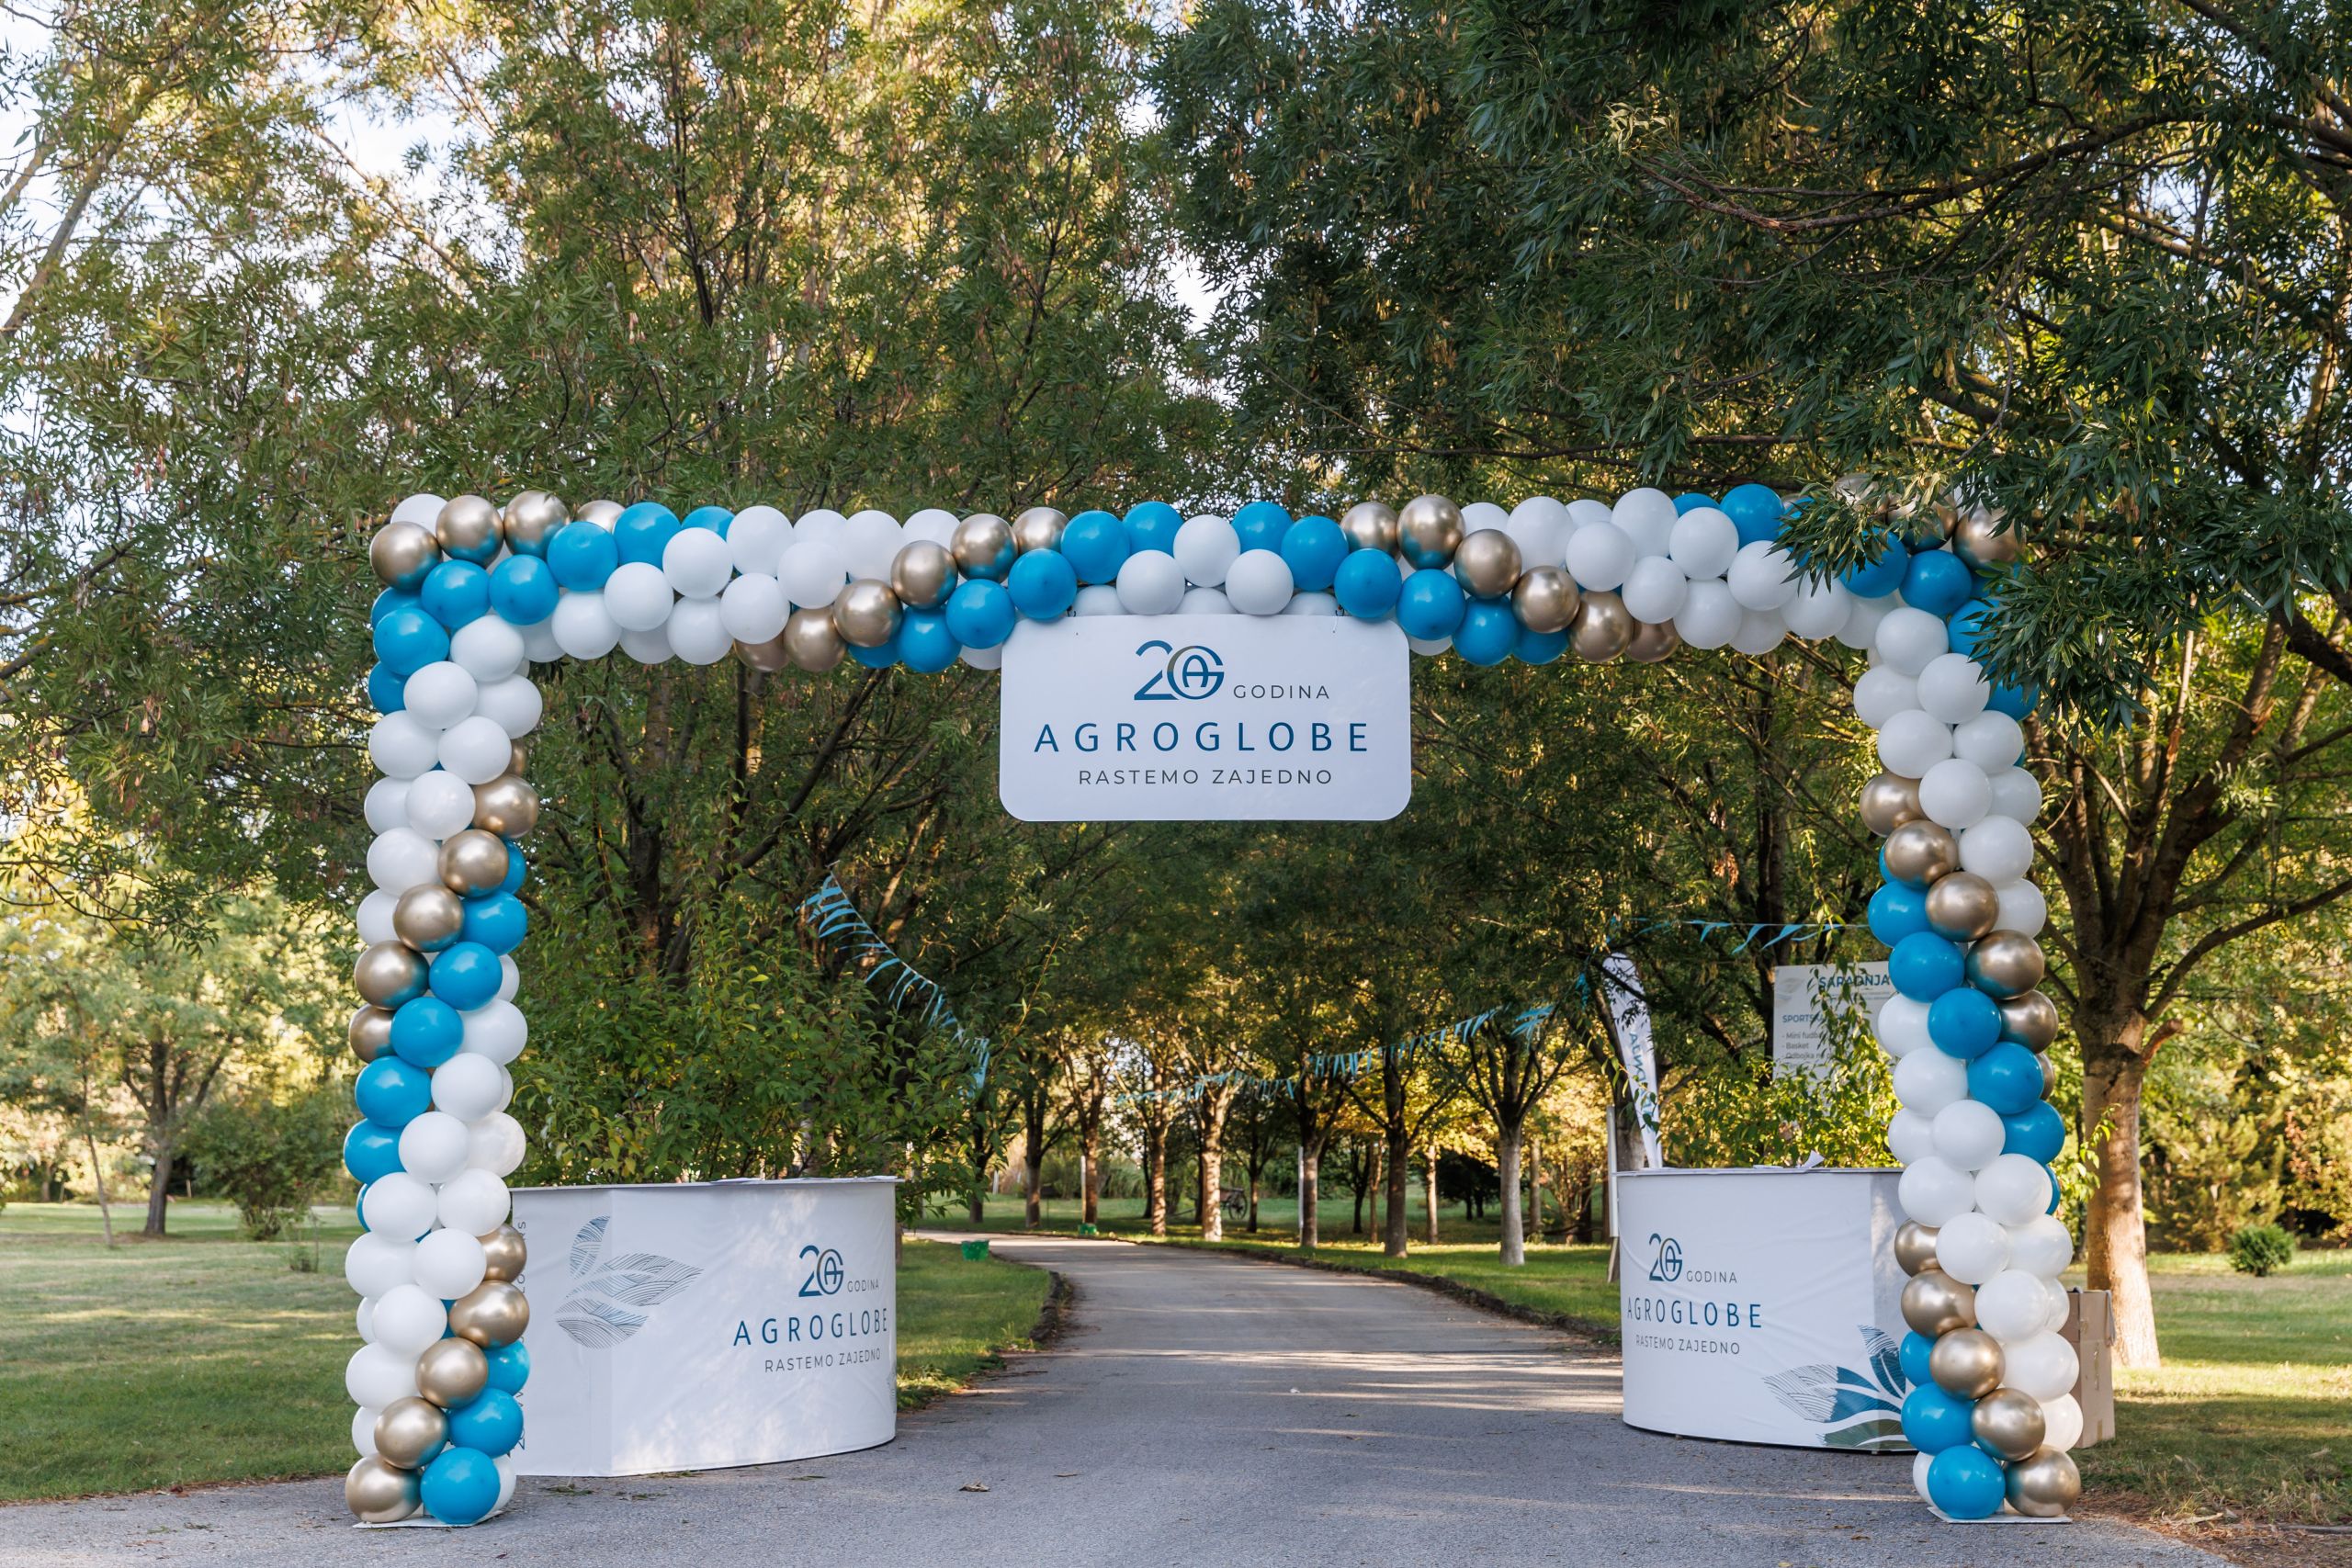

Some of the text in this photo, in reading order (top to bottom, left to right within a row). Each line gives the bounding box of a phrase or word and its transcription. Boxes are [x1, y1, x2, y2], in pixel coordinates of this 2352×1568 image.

[1233, 684, 1329, 700] GODINA
[1034, 722, 1368, 752] AGROGLOBE
[1079, 770, 1332, 785] RASTEMO ZAJEDNO
[847, 1279, 879, 1292] GODINA
[1686, 1270, 1737, 1283] GODINA
[1627, 1296, 1761, 1328] AGROGLOBE
[733, 1308, 888, 1346] AGROGLOBE
[1635, 1334, 1740, 1355] RASTEMO ZAJEDNO
[764, 1347, 881, 1372] RASTEMO ZAJEDNO
